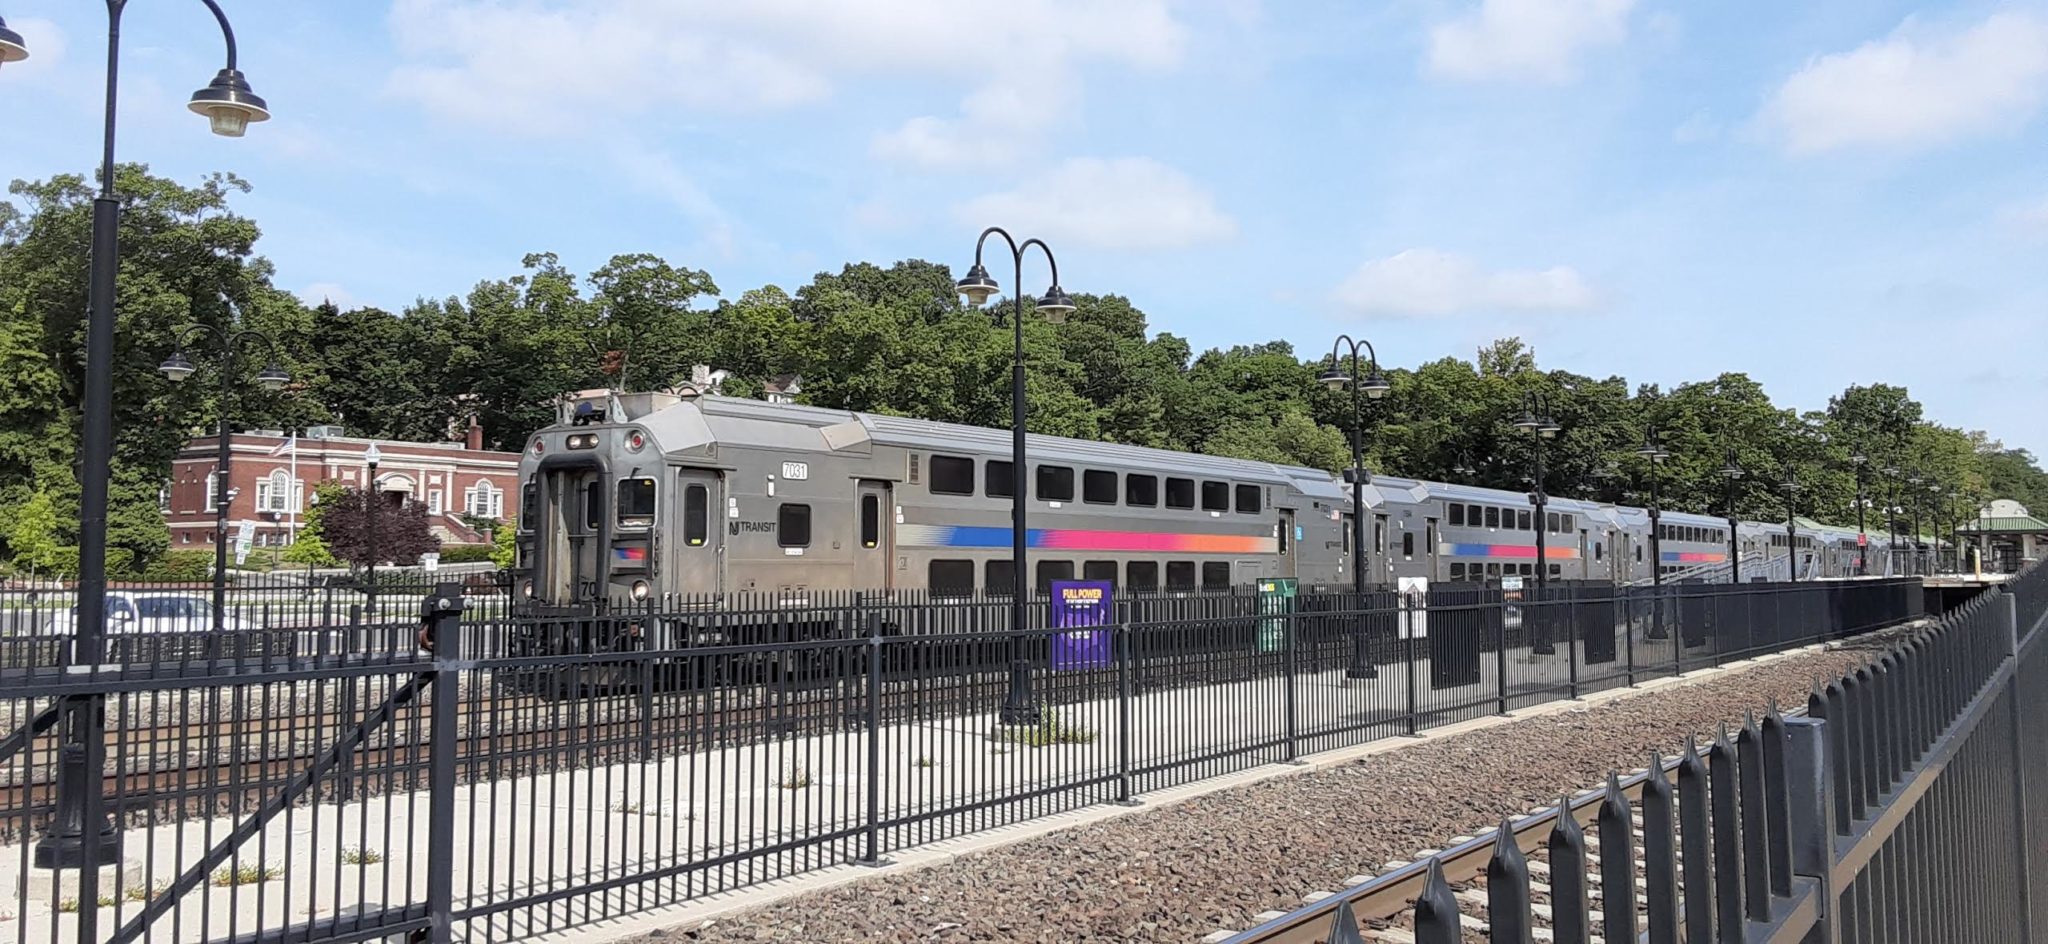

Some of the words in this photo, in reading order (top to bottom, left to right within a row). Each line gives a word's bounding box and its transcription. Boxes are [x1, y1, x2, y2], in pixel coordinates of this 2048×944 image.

[784, 463, 806, 479] 7031
[740, 521, 777, 533] TRANSIT
[1062, 588, 1078, 599] FULL
[1078, 588, 1102, 599] POWER
